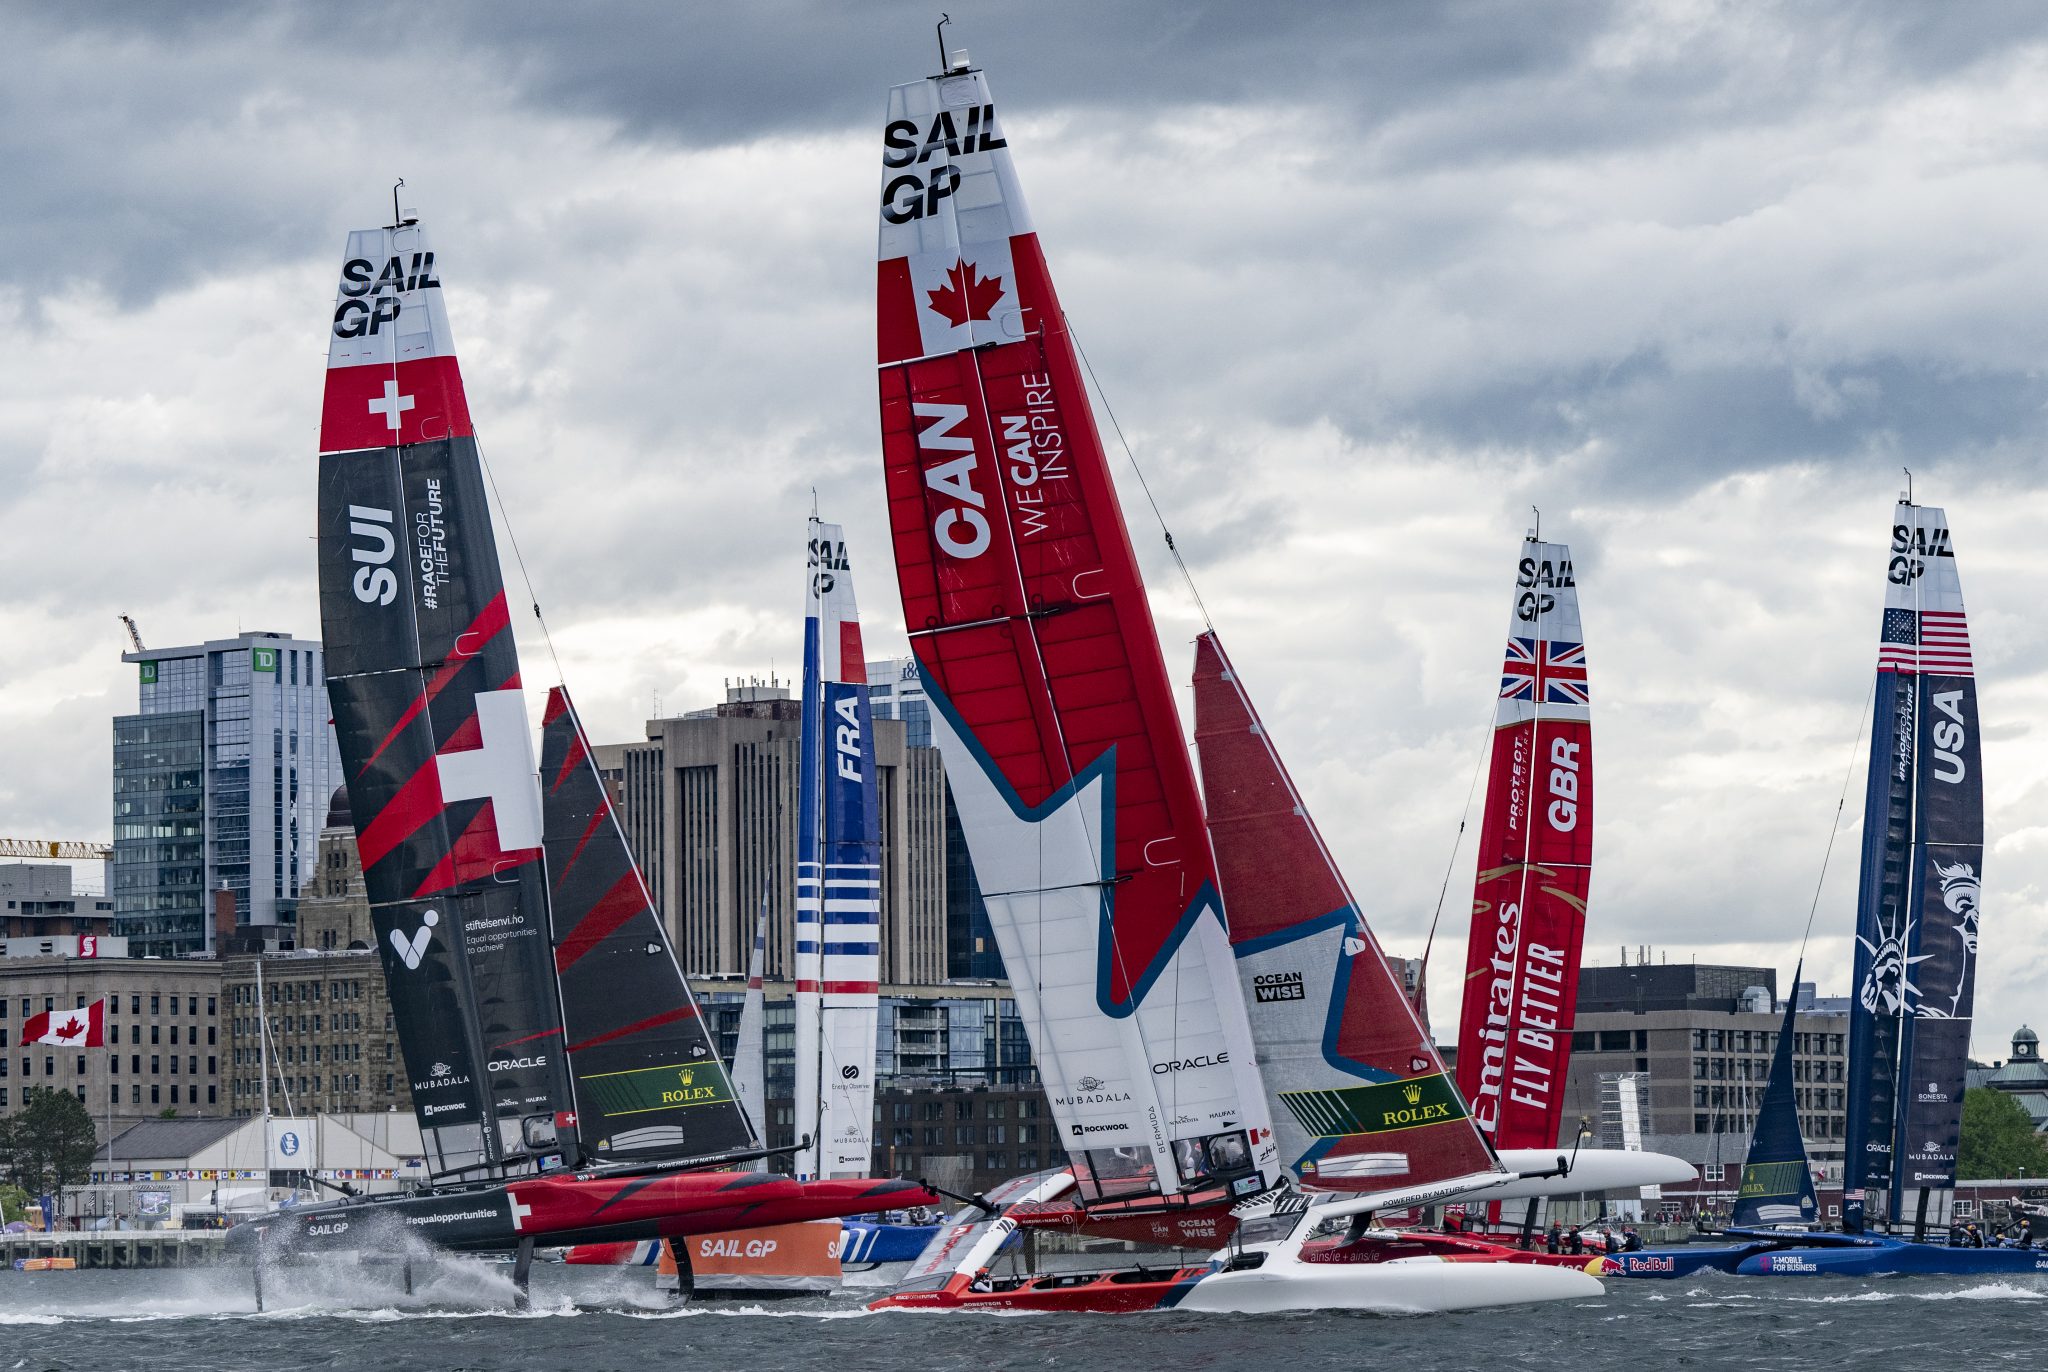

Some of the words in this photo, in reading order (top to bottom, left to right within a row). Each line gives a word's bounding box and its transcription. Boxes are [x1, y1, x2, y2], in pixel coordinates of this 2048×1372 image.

[882, 104, 1008, 168] SAIL
[881, 164, 962, 224] GP
[339, 252, 441, 297] SAIL
[333, 296, 402, 338] GP
[1021, 372, 1069, 480] INSPIRE
[1001, 415, 1038, 487] CAN
[912, 402, 991, 559] CAN
[1016, 489, 1049, 537] WE
[1890, 524, 1955, 557] SAIL
[349, 504, 398, 606] SUI
[1517, 557, 1576, 589] SAIL
[1887, 556, 1925, 587] GP
[1517, 591, 1555, 623] GP
[256, 651, 273, 667] TD
[143, 665, 155, 678] TD
[835, 696, 863, 783] FRA
[1933, 689, 1966, 784] USA
[1509, 736, 1523, 830] PROTECT
[1547, 737, 1580, 832] GBR
[466, 934, 487, 945] Equal
[488, 928, 538, 941] opportunities
[467, 947, 475, 955] to
[476, 943, 504, 953] achieve
[1254, 971, 1303, 985] OCEAN
[1258, 984, 1304, 1001] WISE
[1517, 942, 1565, 1052] BETTER
[1471, 902, 1519, 1133] Emirates
[487, 1055, 547, 1072] ORACLE
[1152, 1052, 1230, 1075] ORACLE
[414, 1075, 470, 1091] MUBADALA
[1510, 1055, 1551, 1110] FLY
[661, 1086, 716, 1103] ROLEX
[1056, 1092, 1131, 1106] MUBADALA
[433, 1102, 467, 1113] ROCKWOOL
[1209, 1109, 1236, 1119] HALIFAX
[1382, 1102, 1451, 1126] ROLEX
[1084, 1123, 1129, 1133] ROCKWOOL
[1148, 1105, 1166, 1154] BERMUDA
[1866, 1144, 1891, 1153] ORACLE
[1382, 1194, 1421, 1207] POWERED
[1422, 1191, 1433, 1200] BY
[406, 1208, 498, 1226] #equalopportunities
[309, 1224, 333, 1236] SAIL
[333, 1222, 349, 1233] GP
[1182, 1228, 1217, 1238] WISE
[699, 1239, 744, 1258] SAIL
[745, 1239, 777, 1258] GP
[1772, 1256, 1803, 1264] T-MOBILE
[1629, 1257, 1652, 1272] Red
[1652, 1256, 1674, 1271] Bull
[1772, 1263, 1786, 1272] FOR
[1786, 1263, 1817, 1272] BUSINESS
